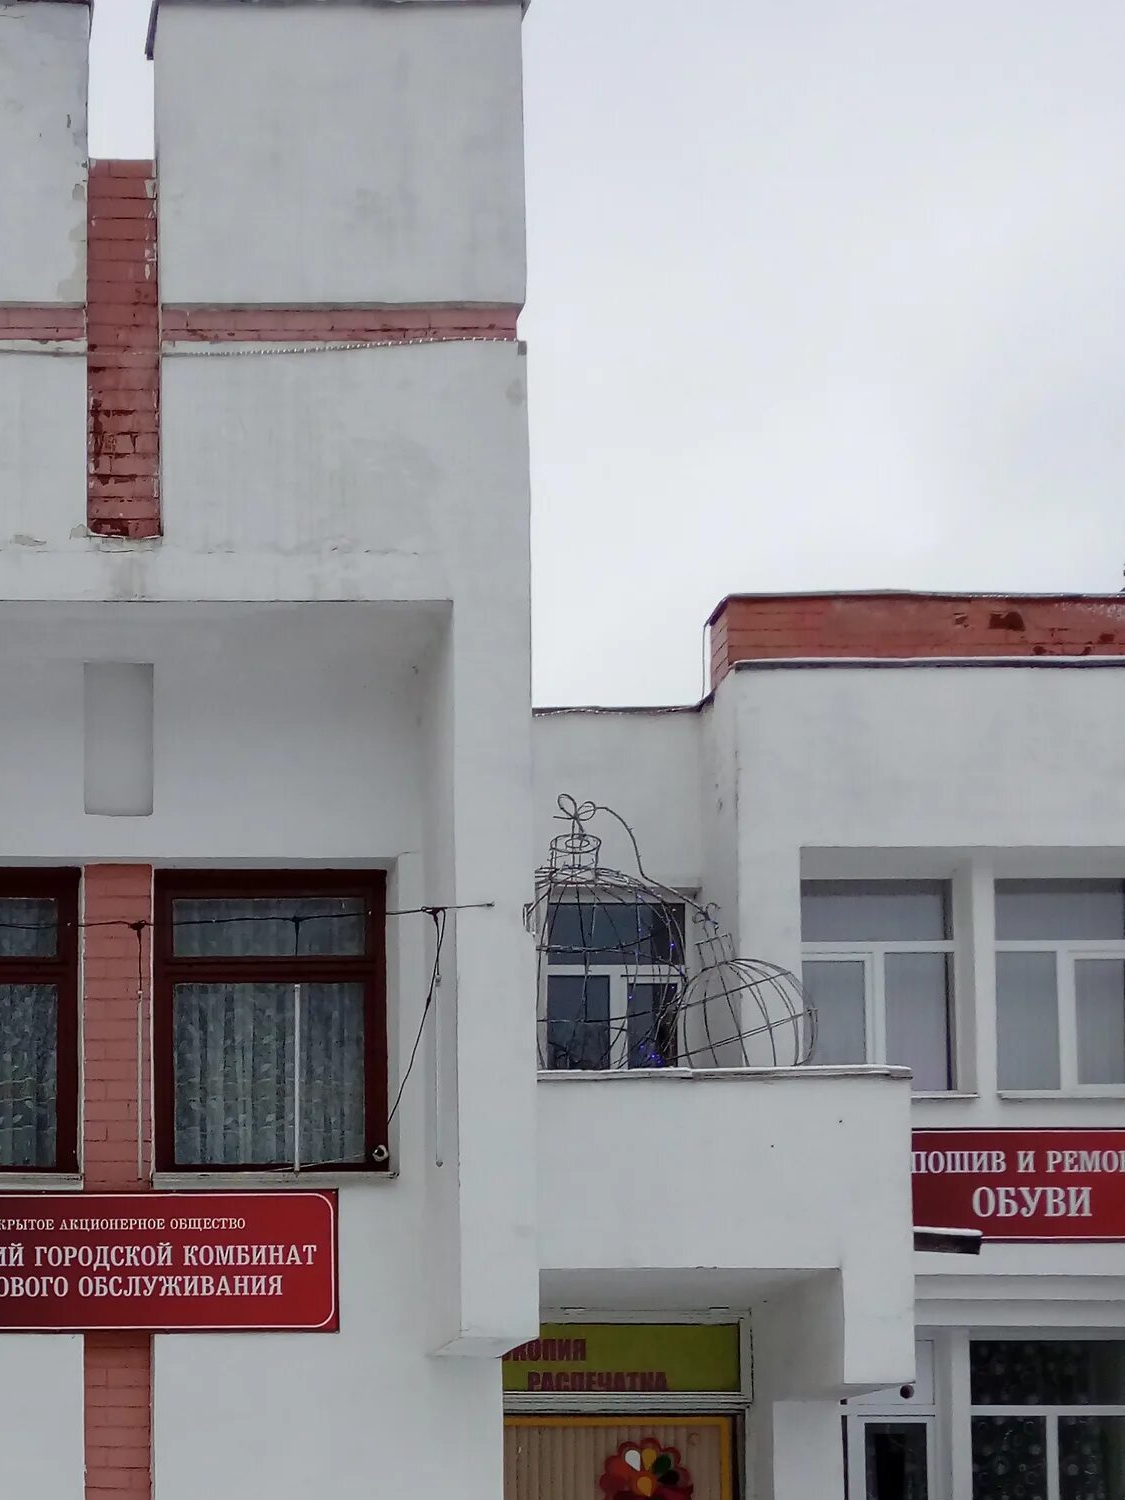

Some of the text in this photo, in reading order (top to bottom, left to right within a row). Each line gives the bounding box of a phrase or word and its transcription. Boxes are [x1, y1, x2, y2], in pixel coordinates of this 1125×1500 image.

[911, 1150, 1007, 1174] ПОШИВ
[1017, 1151, 1036, 1173] И
[972, 1186, 1093, 1217] ОБУВИ
[59, 1218, 165, 1232] АКЦИОНЕРНОЕ
[170, 1217, 246, 1231] ОБЩЕСТВО
[35, 1242, 173, 1271] ГОРОДСКОЙ
[183, 1244, 317, 1267] КОМБИНАТ
[78, 1275, 283, 1297] ОБСЛУЖИВАНИЯ
[527, 1371, 670, 1391] РАСПЕЧАТКА
